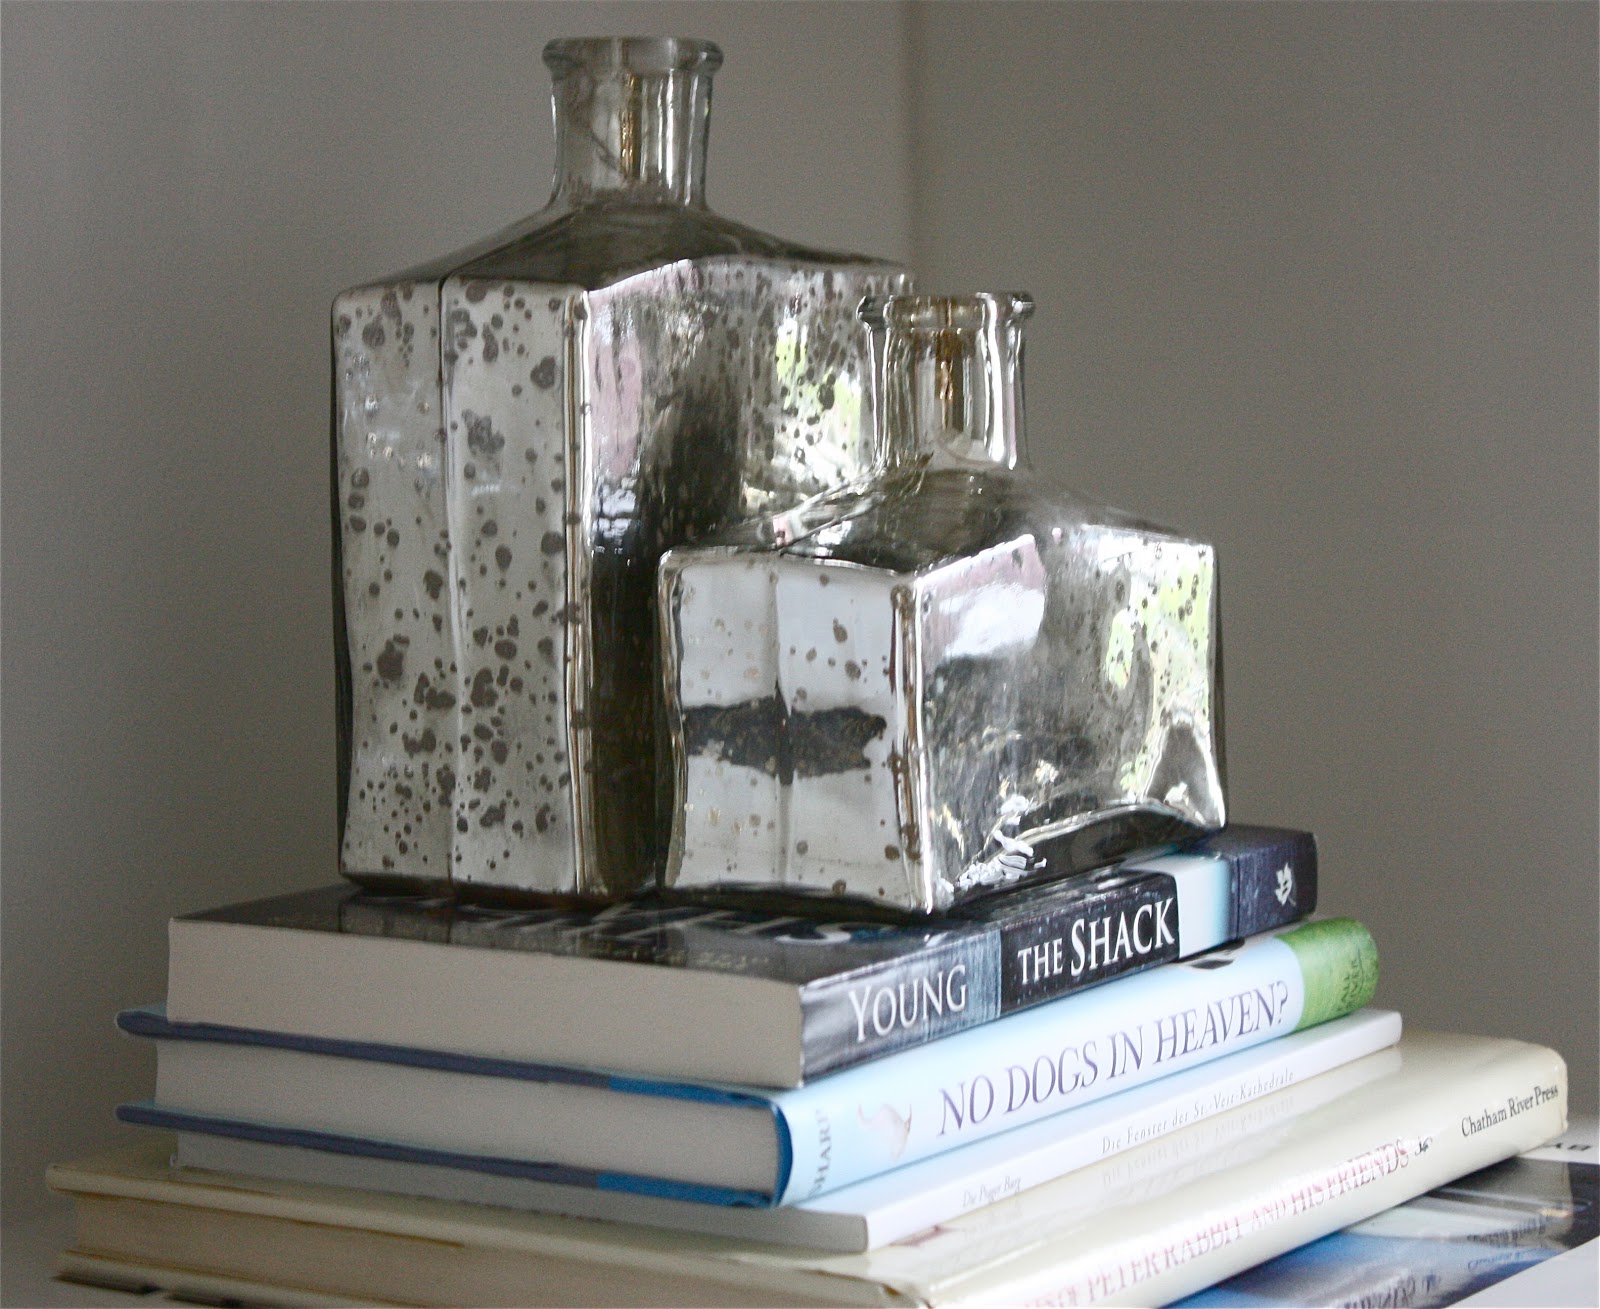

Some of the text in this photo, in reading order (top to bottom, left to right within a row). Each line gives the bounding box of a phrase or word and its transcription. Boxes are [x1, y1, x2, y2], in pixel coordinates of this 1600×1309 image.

[1017, 897, 1175, 986] THE SHACK
[849, 964, 968, 1043] YOUNG
[936, 1076, 995, 1136] NO
[1004, 1039, 1098, 1115] DOGS
[1105, 1024, 1144, 1081] IN
[1153, 979, 1290, 1065] HEAVEN?
[1101, 1136, 1121, 1154] Die
[1126, 1120, 1168, 1144] Fenster
[1172, 1107, 1189, 1128] der
[1460, 1084, 1560, 1138] Chatham River Press
[1326, 1138, 1410, 1200] FRIENDS
